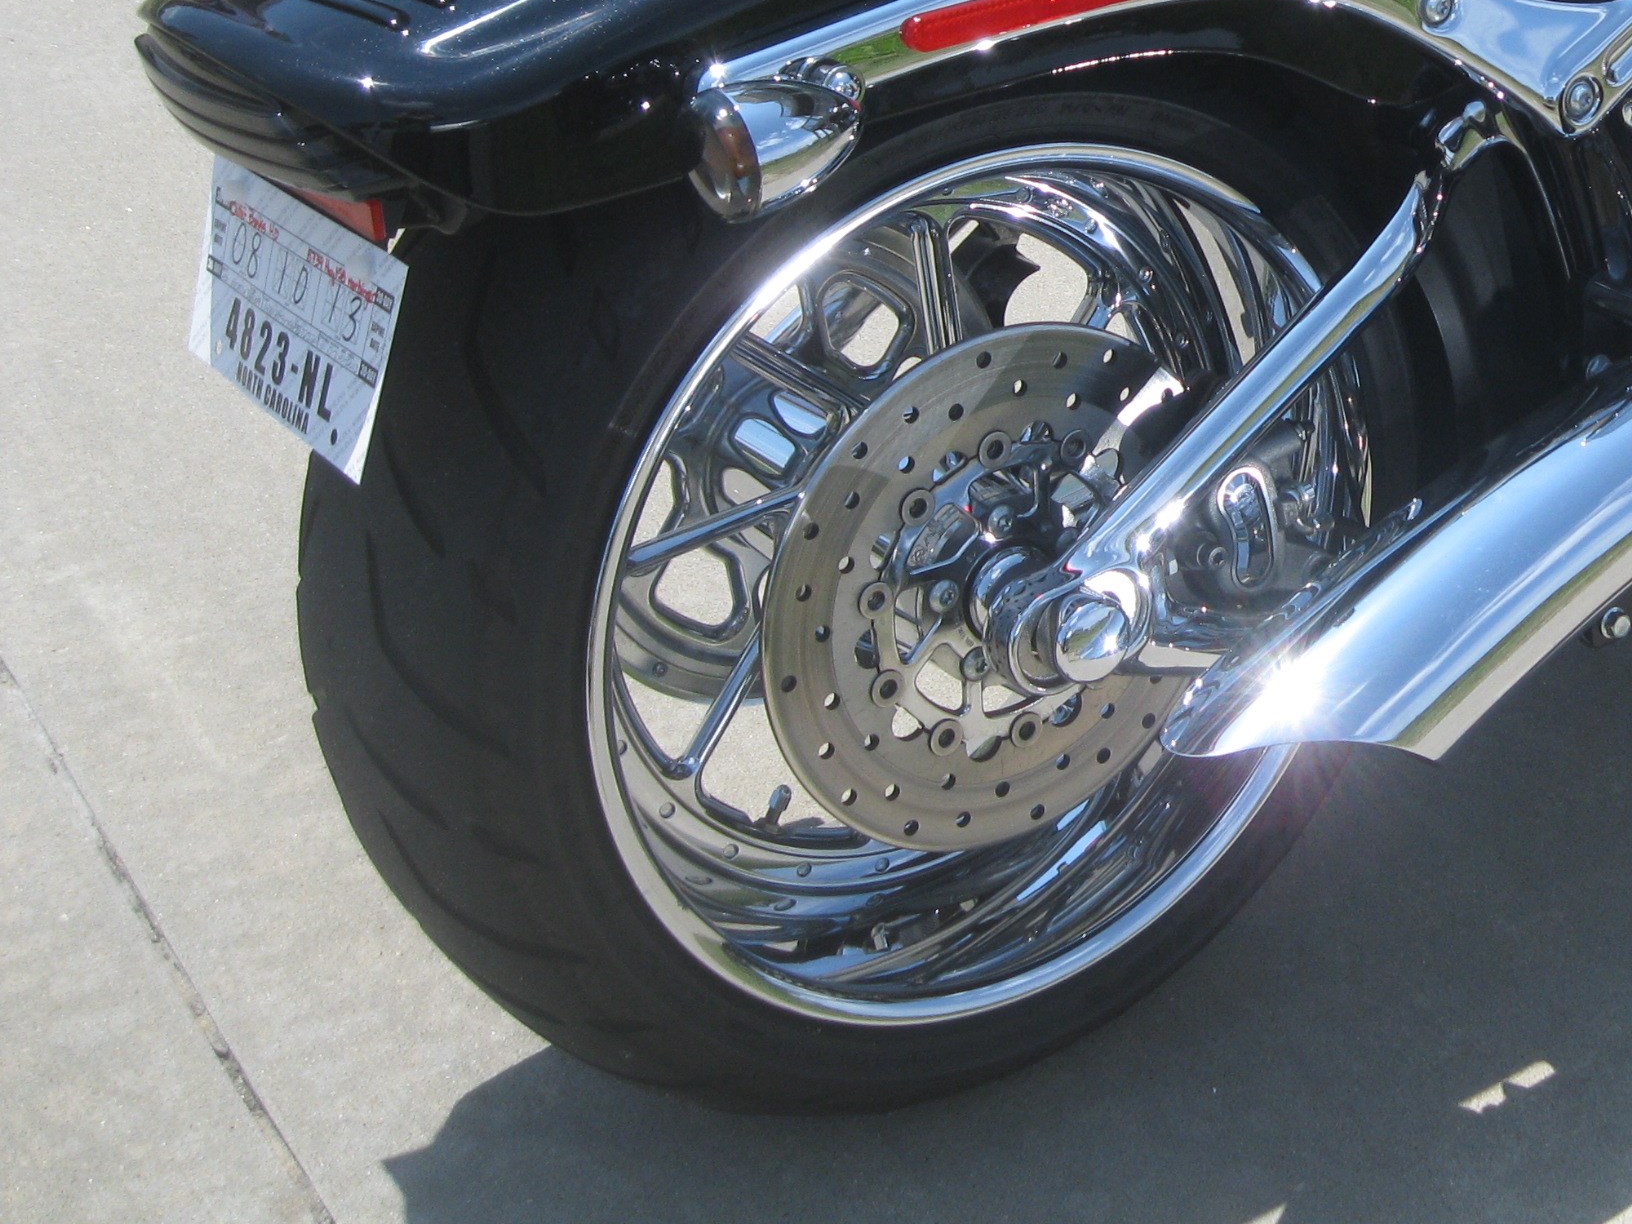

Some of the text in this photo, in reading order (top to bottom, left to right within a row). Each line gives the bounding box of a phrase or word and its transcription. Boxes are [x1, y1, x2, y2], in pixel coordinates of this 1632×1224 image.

[232, 221, 263, 279] 08
[276, 250, 309, 306] 10
[327, 282, 364, 343] 13
[224, 296, 333, 422] 4823-NL
[234, 361, 311, 436] NORTH CAROLINA
